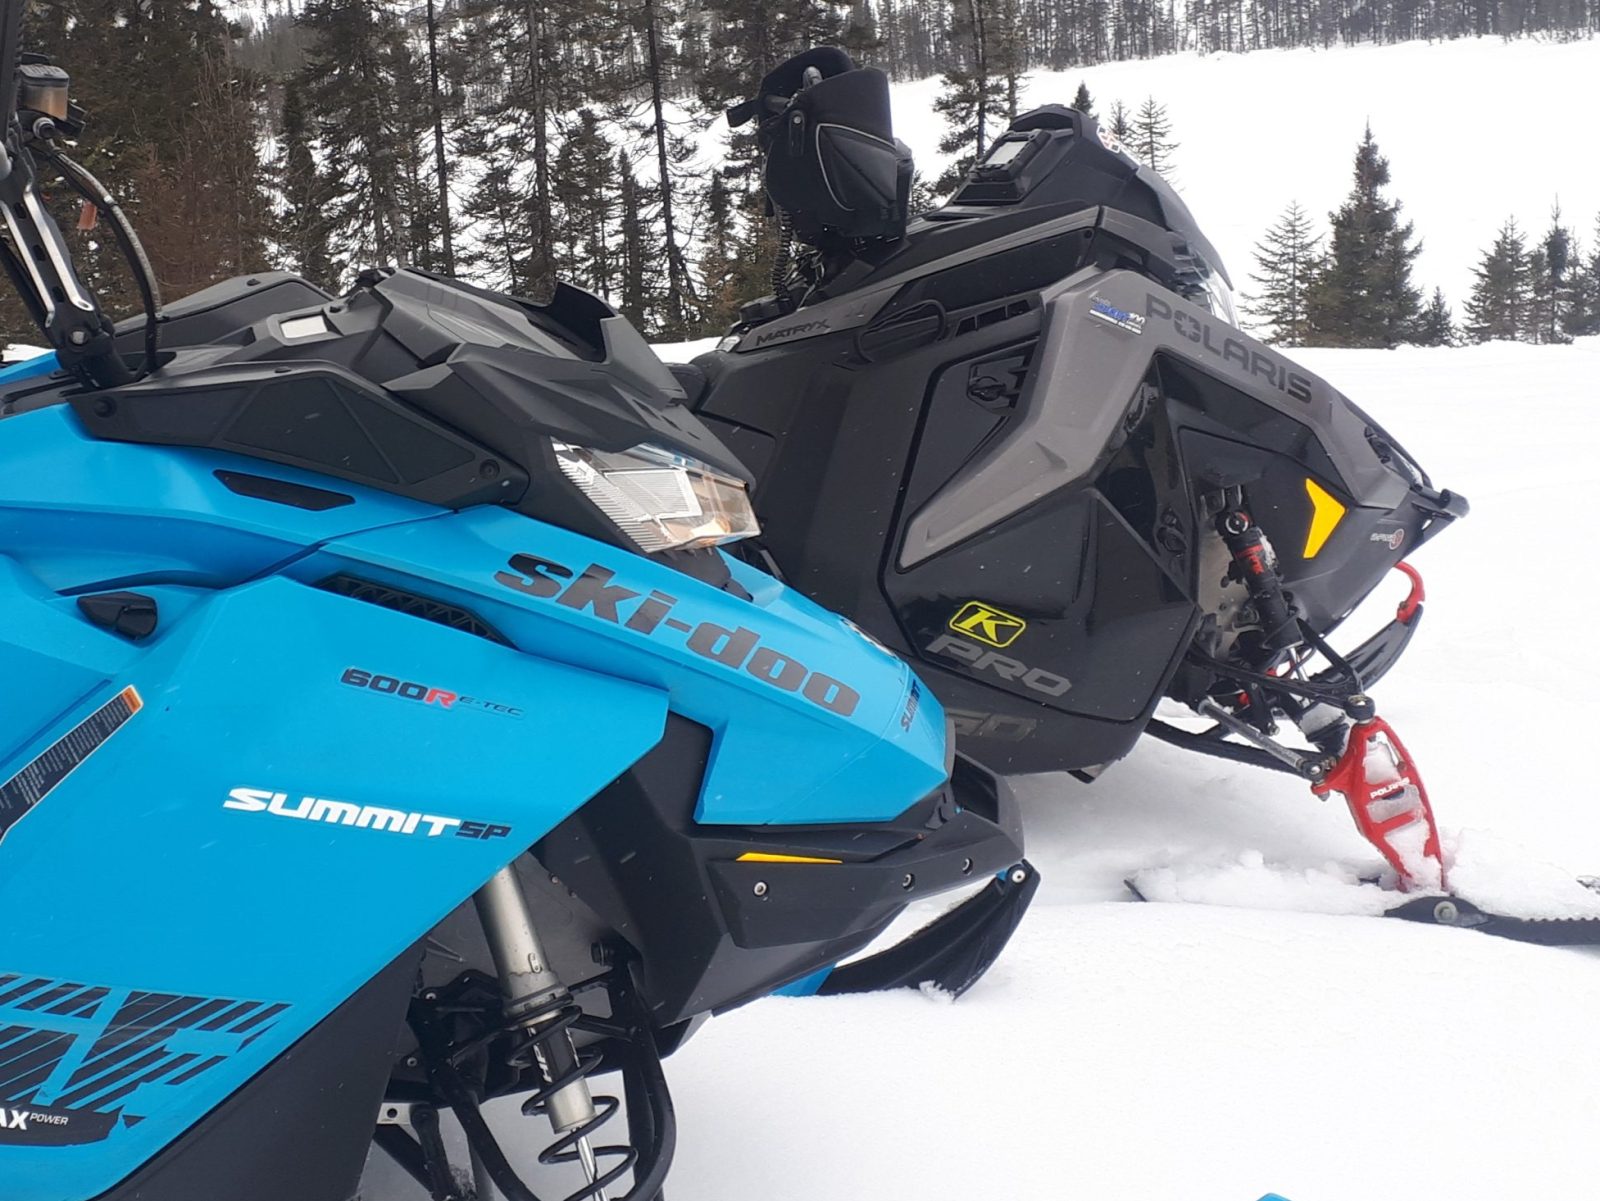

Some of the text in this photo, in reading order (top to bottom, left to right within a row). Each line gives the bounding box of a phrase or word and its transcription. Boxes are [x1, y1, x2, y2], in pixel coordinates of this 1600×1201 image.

[755, 319, 831, 346] MATRYX
[1146, 293, 1312, 404] POLARIS
[494, 553, 861, 717] ski-doo
[340, 668, 524, 716] 600R E-TEC
[925, 634, 1072, 697] PRO
[223, 787, 512, 840] SUMMIT SP
[29, 1112, 69, 1126] POWER
